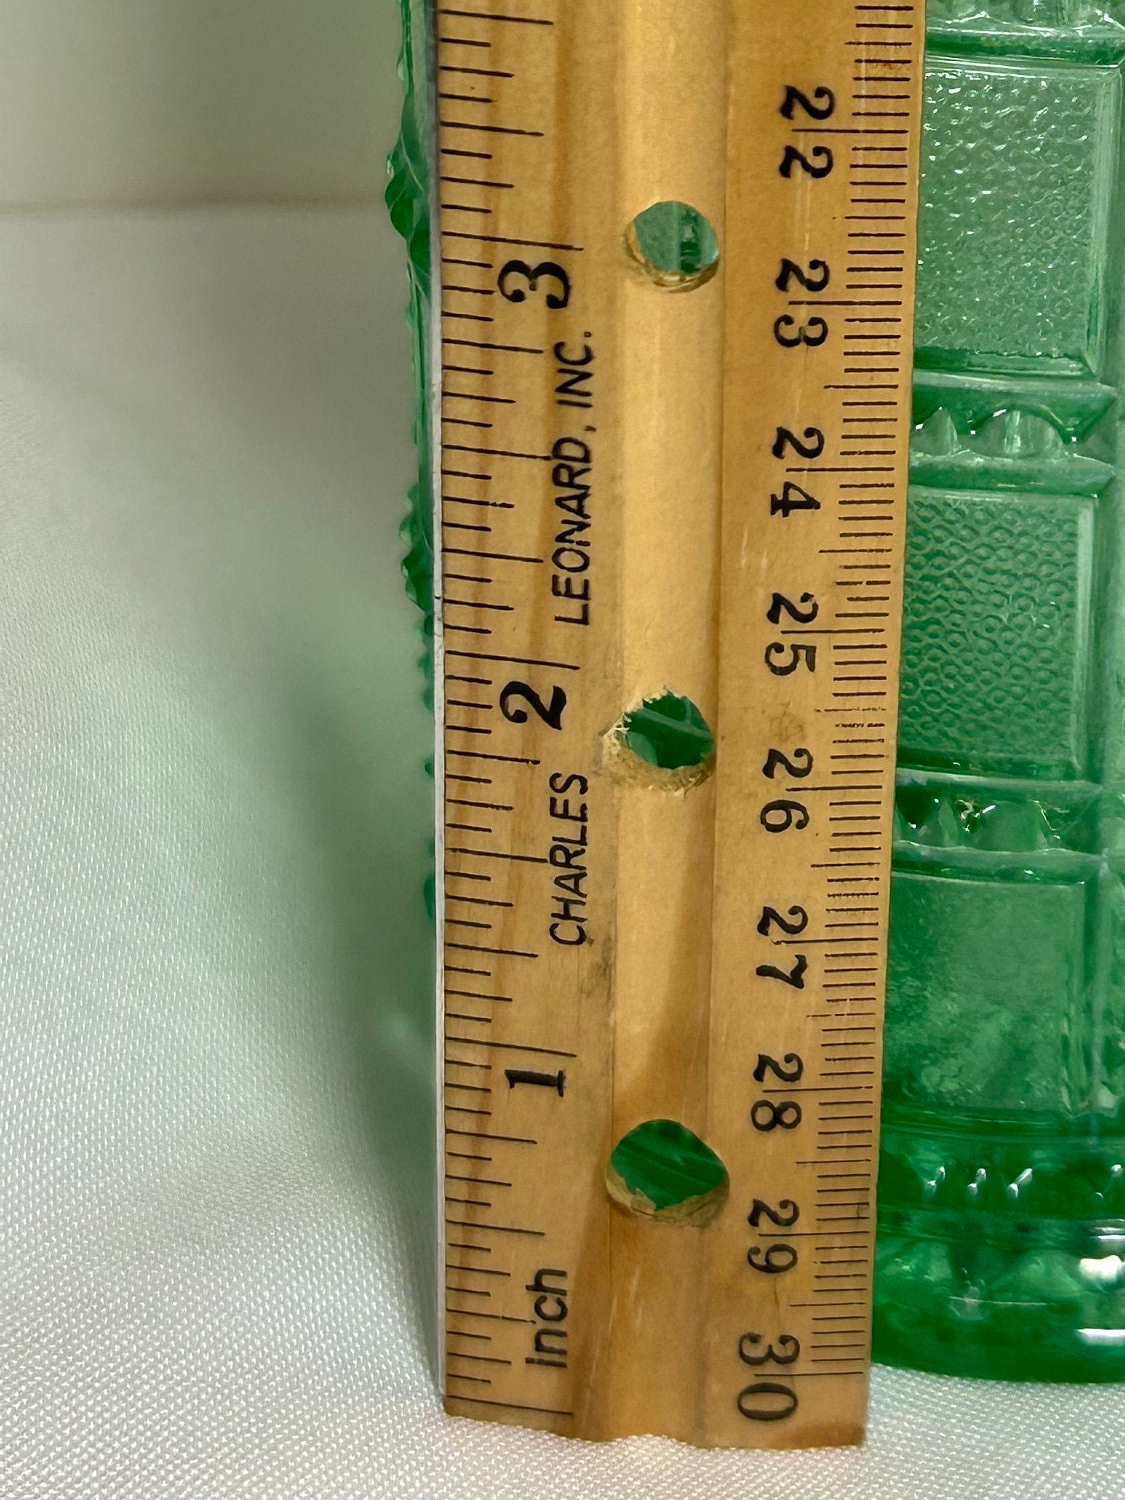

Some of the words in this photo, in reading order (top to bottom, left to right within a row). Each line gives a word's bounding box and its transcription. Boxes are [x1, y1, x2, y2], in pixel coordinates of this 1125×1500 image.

[780, 86, 836, 180] 22
[497, 259, 573, 309] 3
[774, 258, 830, 349] 23
[562, 328, 594, 412] INC.
[769, 426, 824, 519] 24
[553, 424, 596, 626] LEONARD,
[764, 591, 819, 677] 25
[499, 681, 564, 731] 2
[762, 747, 815, 834] 26
[549, 772, 590, 947] CHARLES
[756, 905, 809, 990] 27
[505, 1067, 565, 1099] 1
[752, 1052, 804, 1133] 28
[747, 1198, 799, 1274] 29
[525, 1267, 568, 1369] Inch
[736, 1333, 800, 1423] 30
